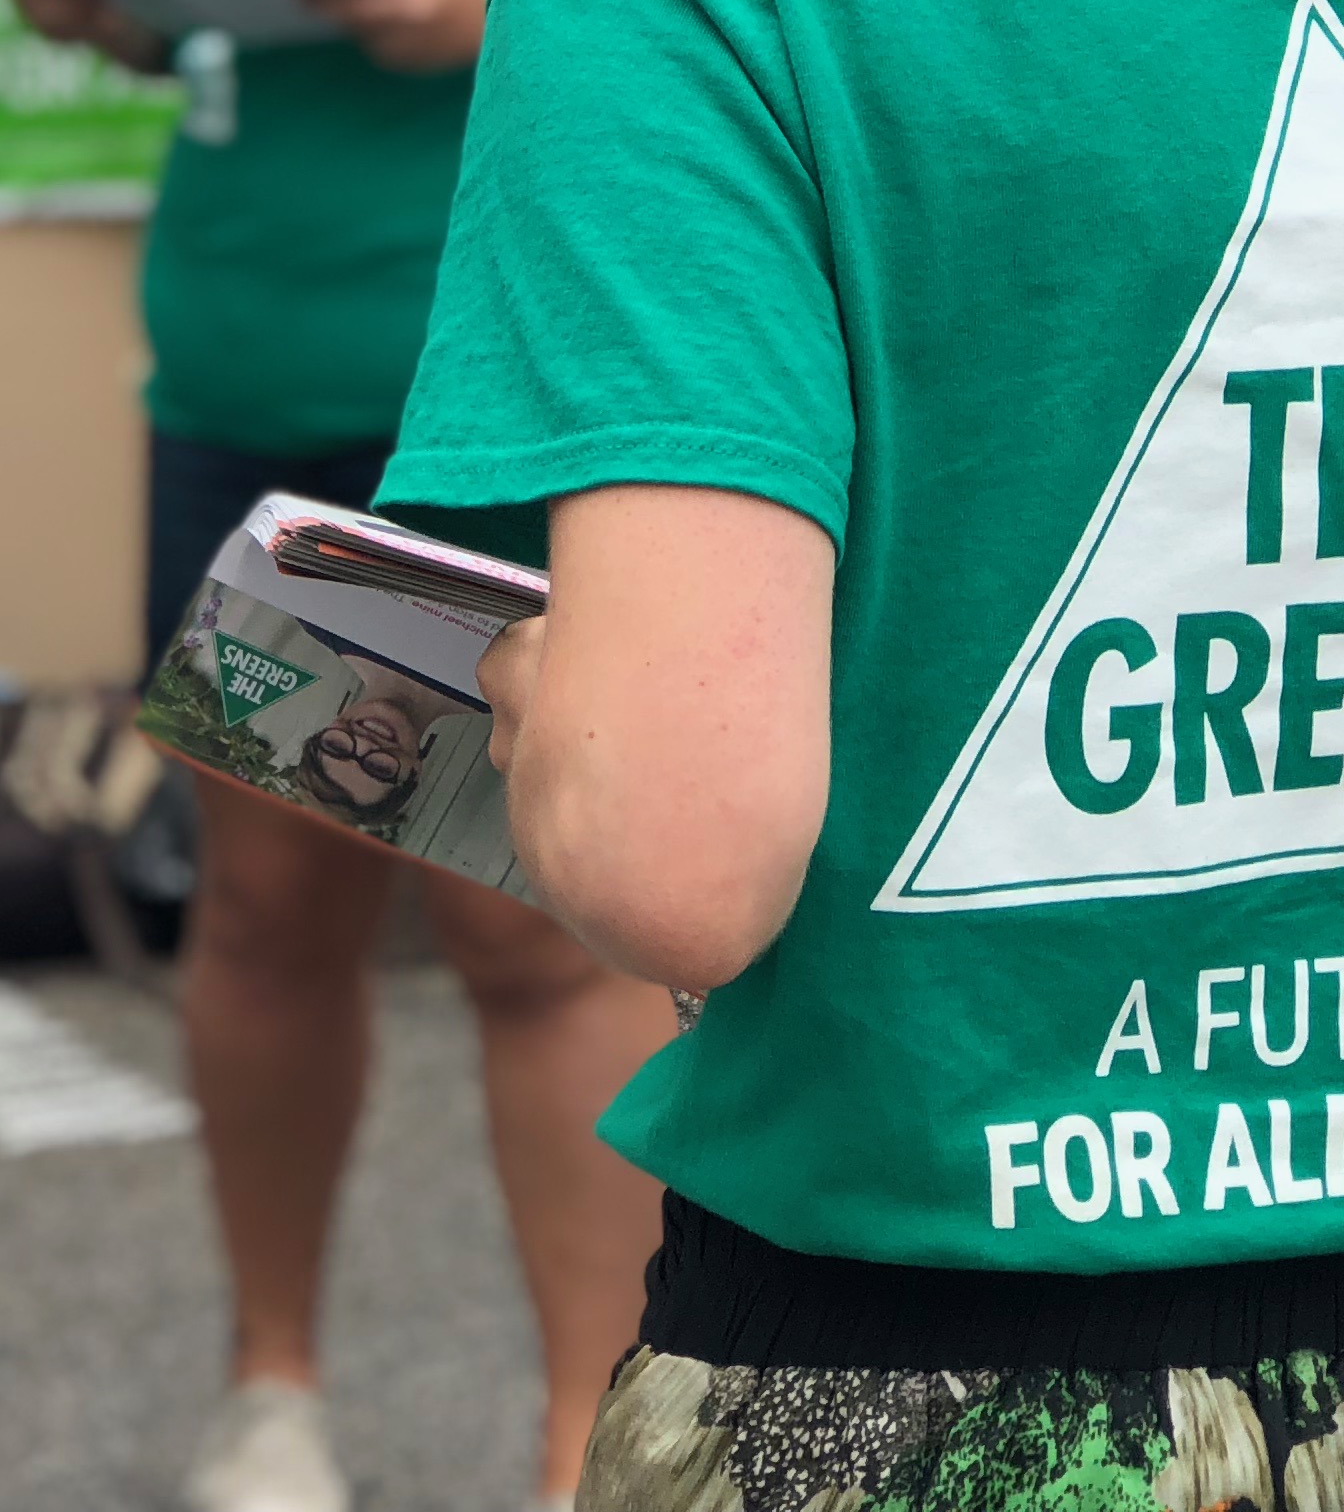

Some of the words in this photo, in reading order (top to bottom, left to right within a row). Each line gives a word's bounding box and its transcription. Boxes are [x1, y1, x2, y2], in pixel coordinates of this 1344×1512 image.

[220, 645, 298, 692] GREENS
[226, 672, 266, 705] THE
[1096, 979, 1161, 1077] A
[985, 1112, 1180, 1229] FOR
